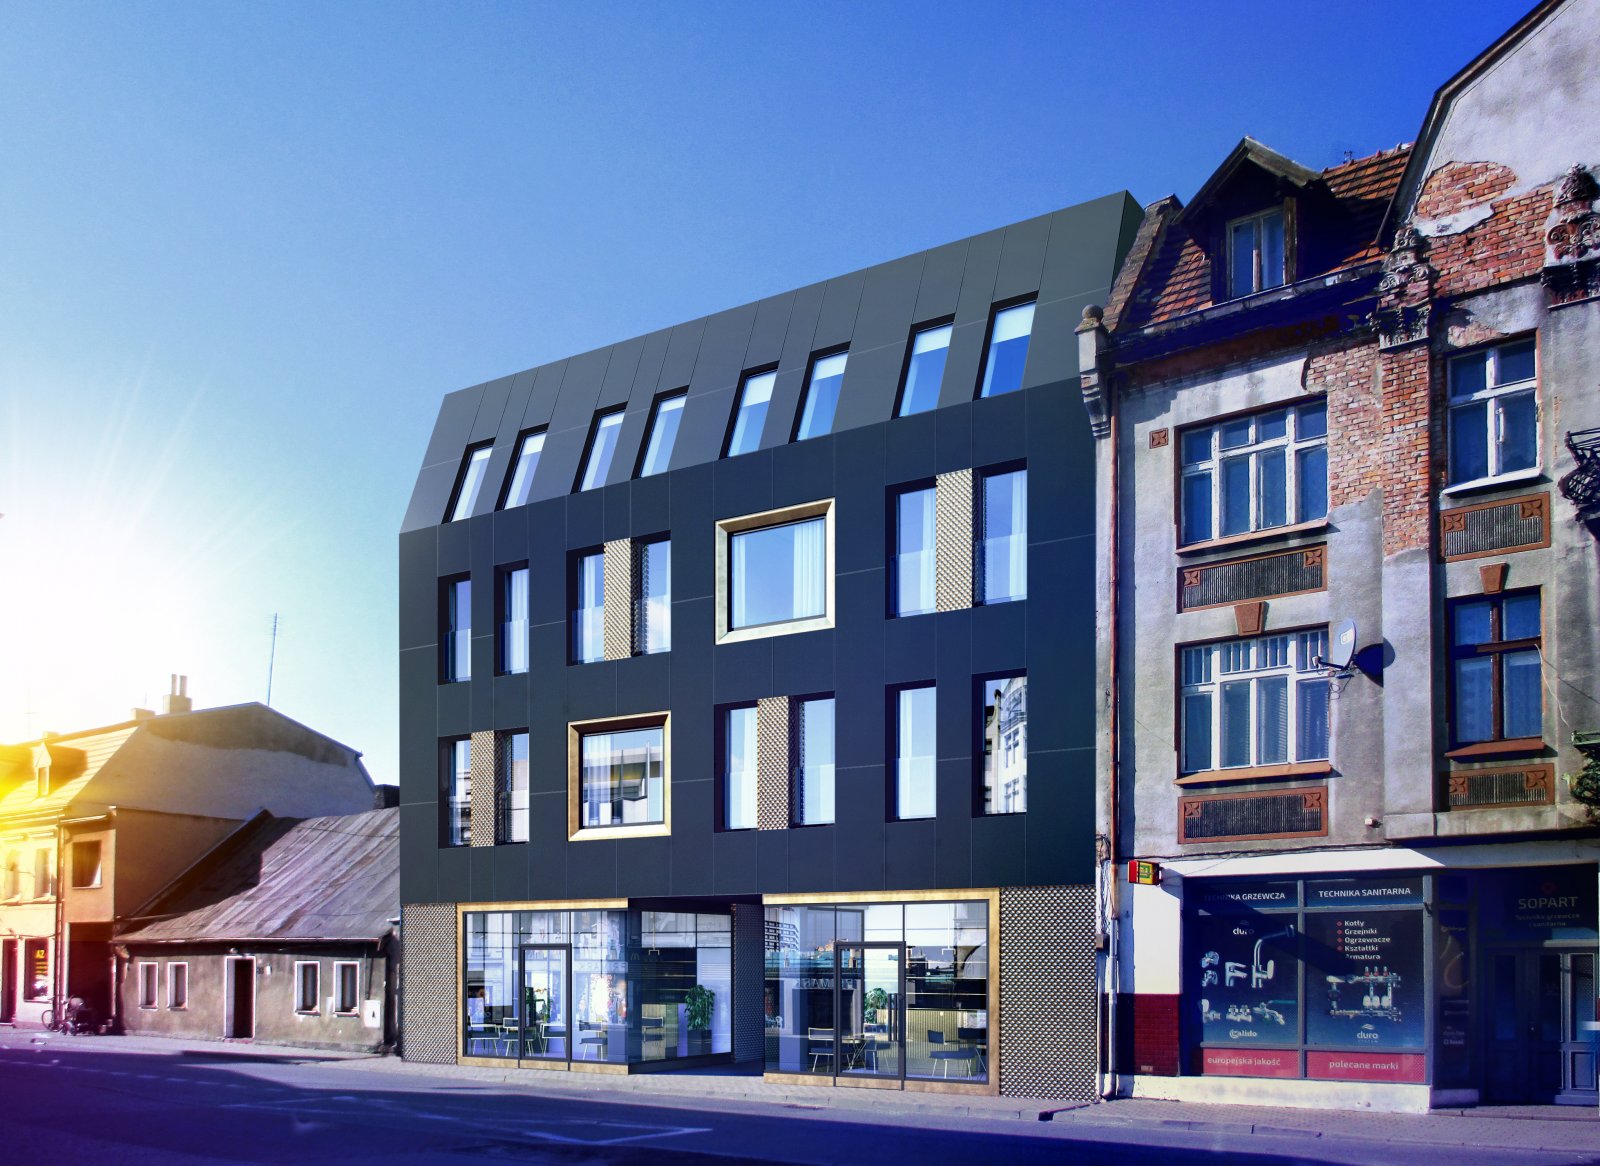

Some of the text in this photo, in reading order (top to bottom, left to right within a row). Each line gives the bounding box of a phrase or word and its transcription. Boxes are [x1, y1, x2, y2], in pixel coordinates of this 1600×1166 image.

[1242, 892, 1286, 900] GRZEWCZA
[1318, 887, 1411, 898] TECHNIKA SANITARNA
[1518, 896, 1579, 910] SOPART
[1356, 1030, 1379, 1039] duro
[1207, 1056, 1281, 1066] europejska jakość
[1329, 1060, 1399, 1070] polecane marki
